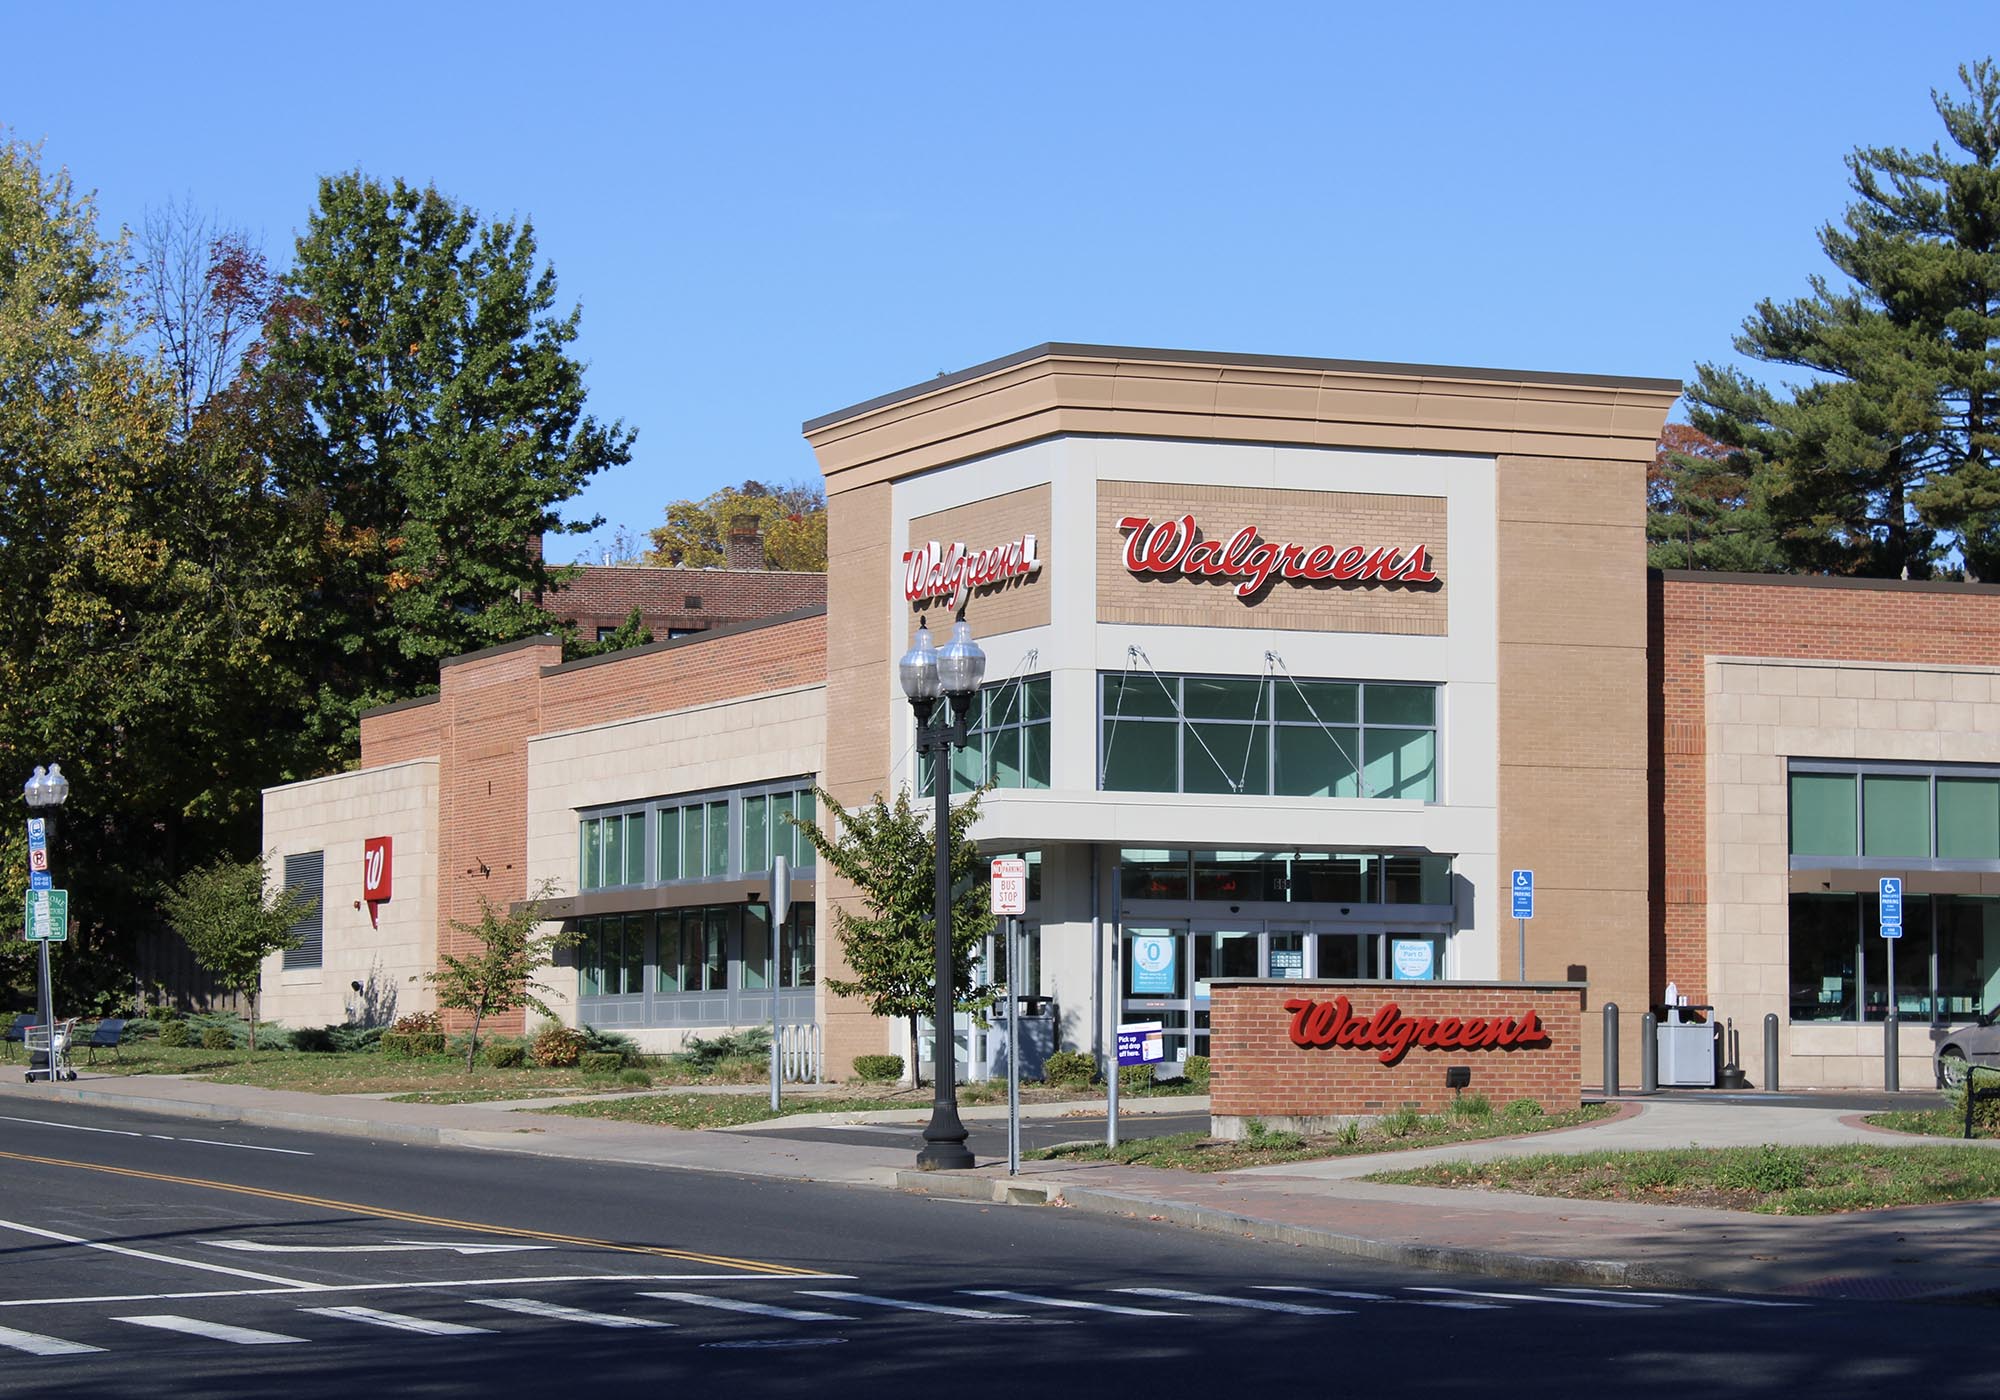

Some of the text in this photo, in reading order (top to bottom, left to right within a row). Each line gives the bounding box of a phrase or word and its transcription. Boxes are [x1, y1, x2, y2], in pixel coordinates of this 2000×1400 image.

[902, 534, 1041, 612] Walgreens
[1116, 514, 1438, 596] Walgreens
[1000, 891, 1018, 902] STOP
[1001, 880, 1016, 890] BUS
[1129, 1042, 1141, 1050] drop
[1284, 995, 1546, 1063] Walgreens
